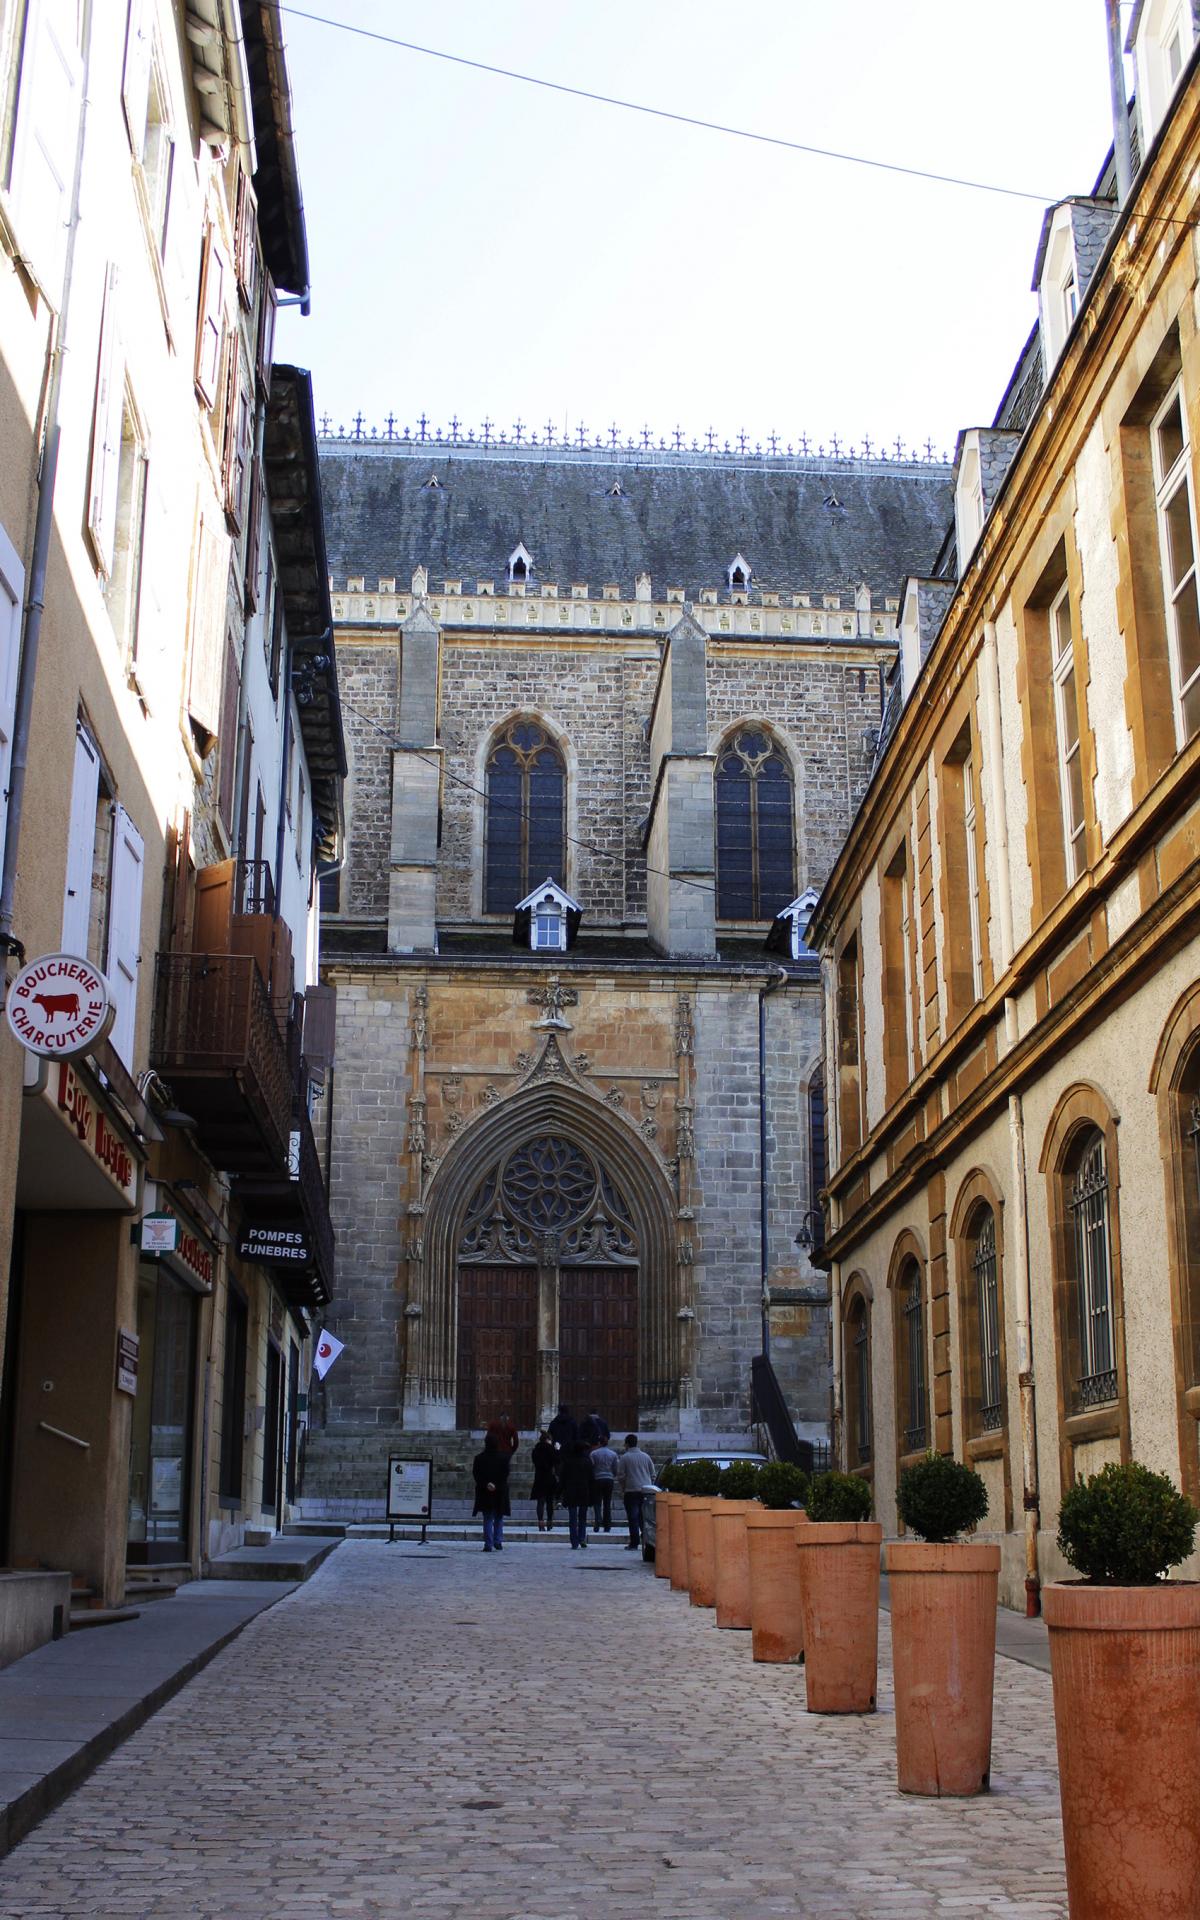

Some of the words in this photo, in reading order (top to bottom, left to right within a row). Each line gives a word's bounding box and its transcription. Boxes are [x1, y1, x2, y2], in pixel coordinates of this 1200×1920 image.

[16, 962, 99, 998] BOUCHERIE
[12, 1001, 102, 1048] CHARCUTERIE
[249, 1229, 303, 1244] POMPES
[240, 1243, 307, 1259] FUNEBRES
